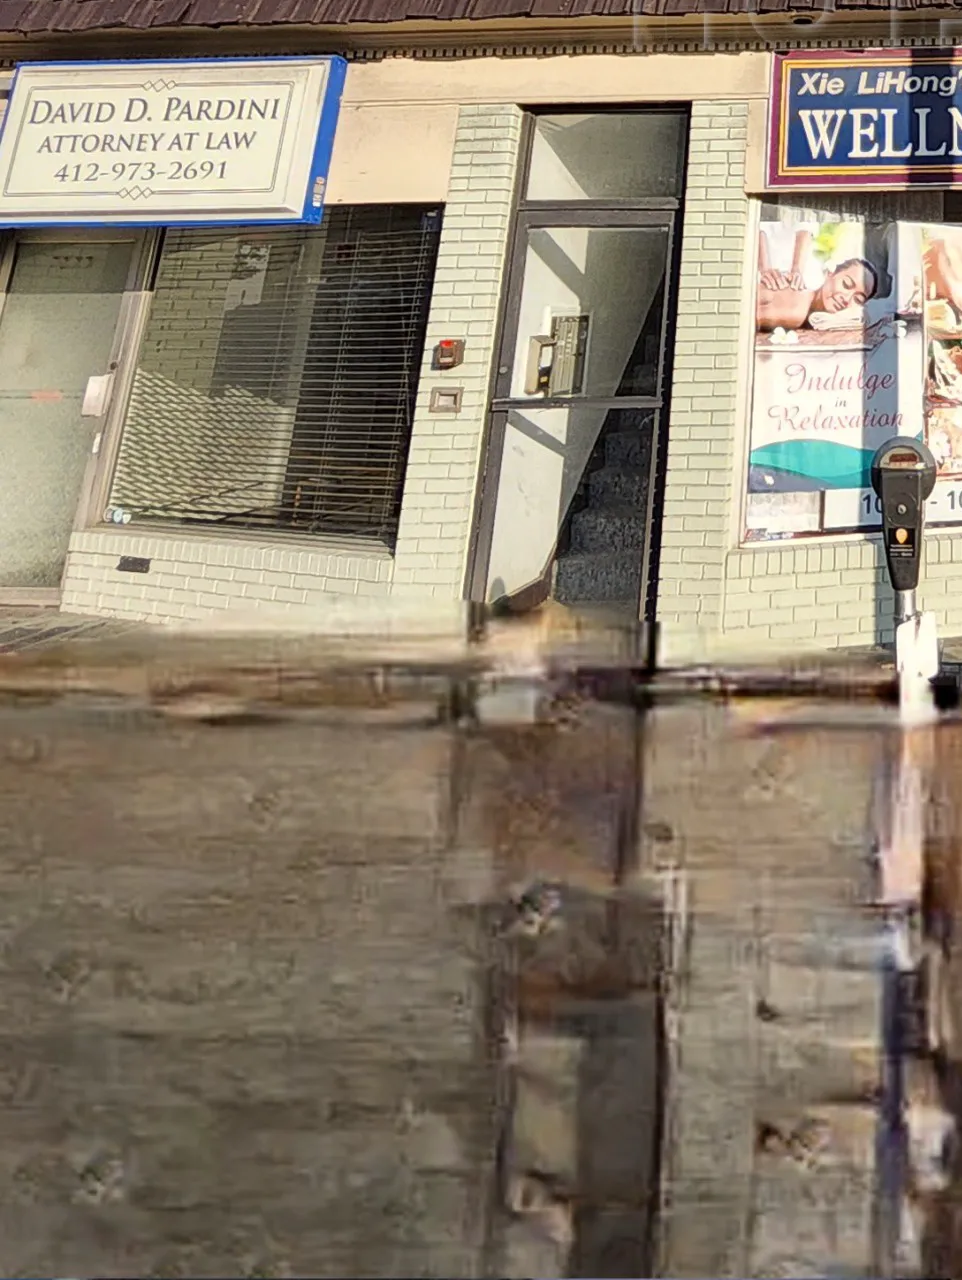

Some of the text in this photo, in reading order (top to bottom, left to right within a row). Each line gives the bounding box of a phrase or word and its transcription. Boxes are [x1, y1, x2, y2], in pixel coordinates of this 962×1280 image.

[797, 72, 845, 95] Xie
[29, 97, 281, 124] DAVID D. PARDINI
[37, 131, 258, 153] ATTORNEY AT LAW
[53, 160, 228, 182] 412-973-2691
[784, 362, 894, 400] Indulge
[835, 397, 848, 408] in
[767, 404, 904, 432] Relaxation
